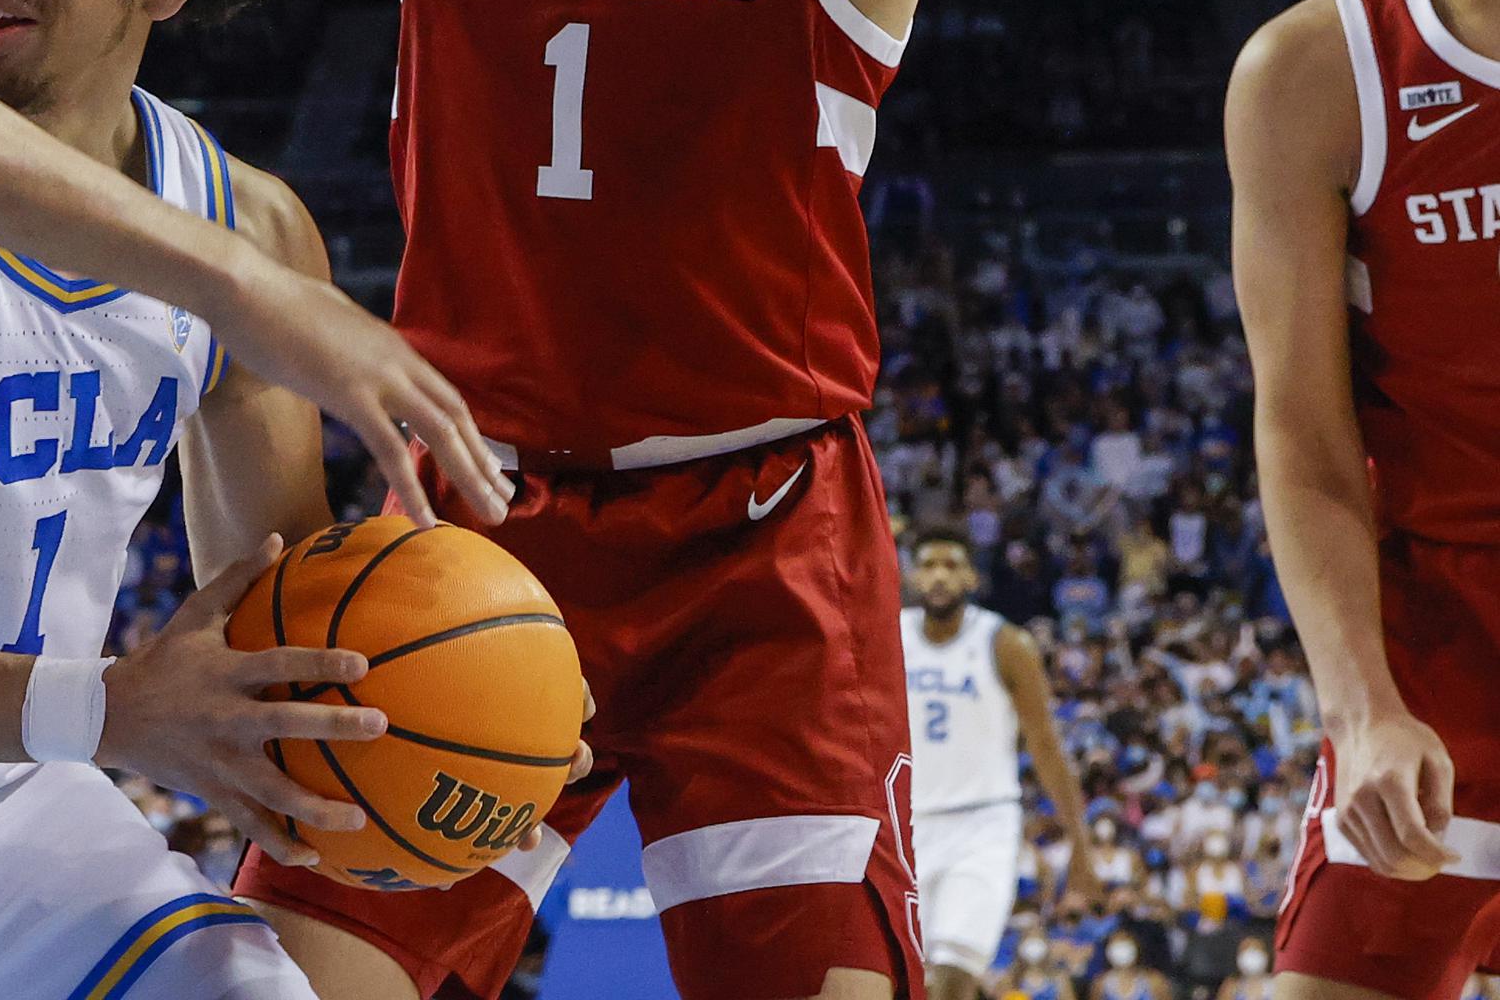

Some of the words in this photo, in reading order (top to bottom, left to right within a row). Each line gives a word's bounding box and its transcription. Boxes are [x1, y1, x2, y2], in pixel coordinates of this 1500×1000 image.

[536, 22, 594, 200] 1
[1, 509, 68, 656] 1
[925, 700, 949, 742] 2
[416, 769, 534, 850] Wil
